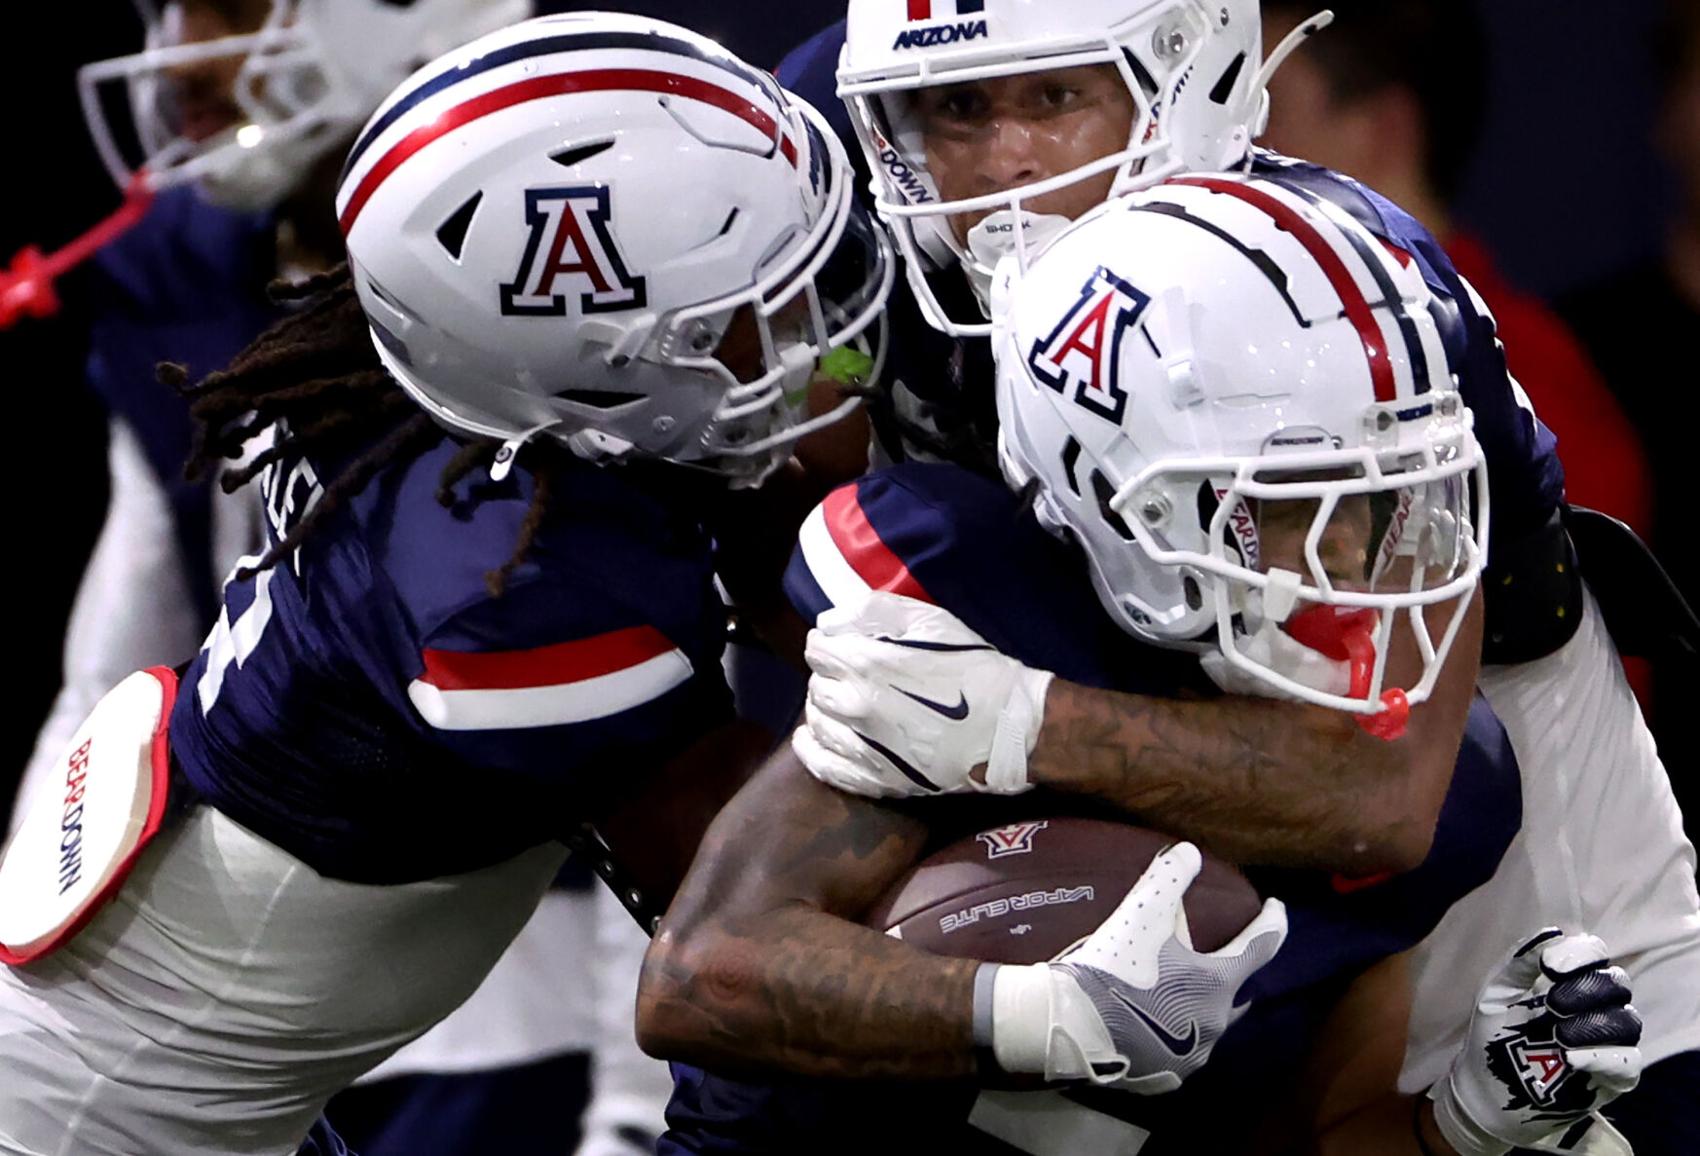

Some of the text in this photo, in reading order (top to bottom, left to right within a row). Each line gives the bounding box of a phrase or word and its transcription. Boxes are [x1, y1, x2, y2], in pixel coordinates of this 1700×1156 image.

[892, 20, 988, 51] ARIZONA
[881, 149, 934, 204] DOWN
[499, 184, 648, 317] A
[986, 220, 1032, 234] SHOK
[1027, 264, 1153, 427] A
[975, 820, 1049, 860] A
[939, 885, 1095, 934] VAPOR ELITE
